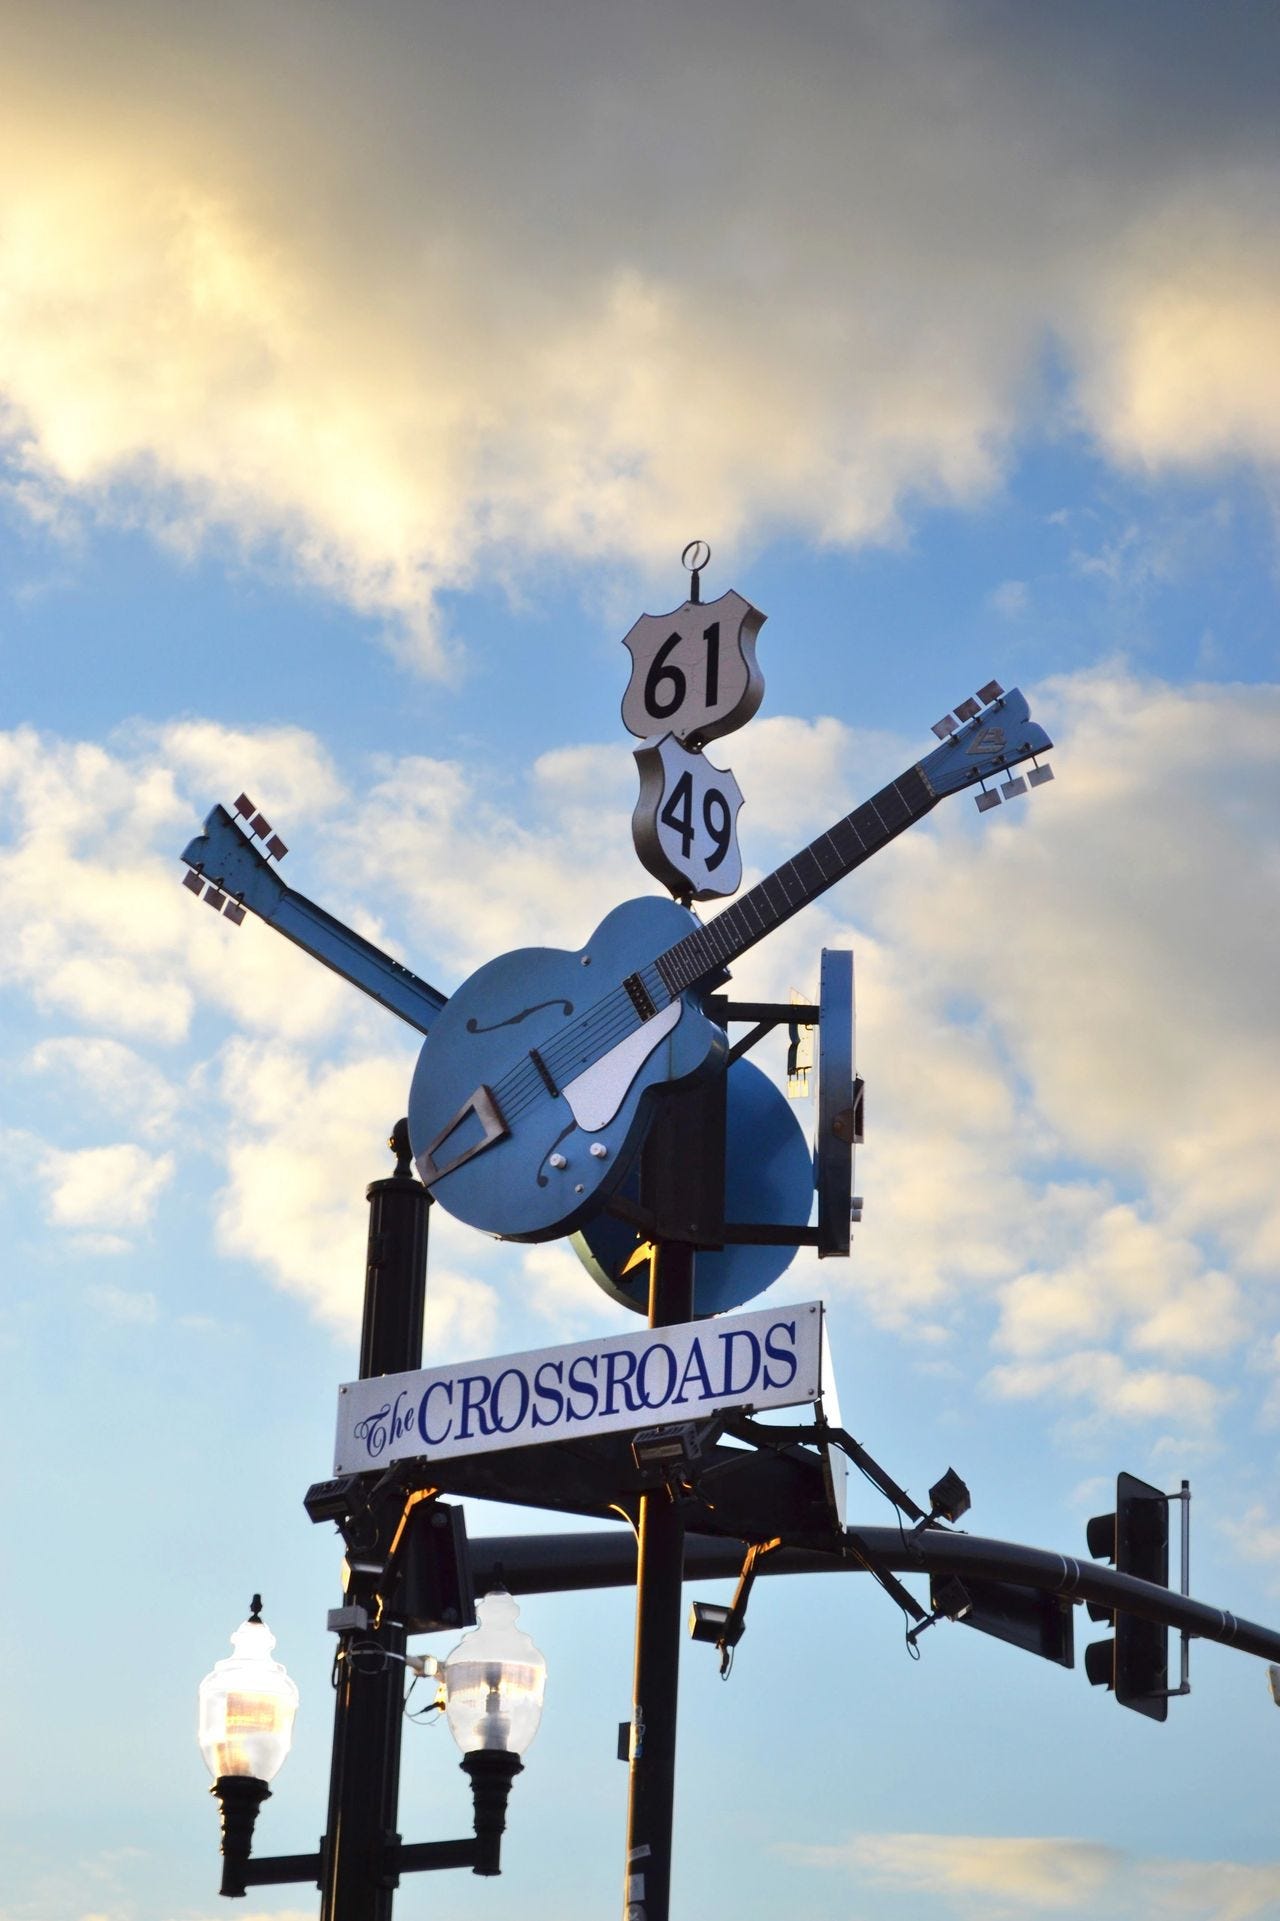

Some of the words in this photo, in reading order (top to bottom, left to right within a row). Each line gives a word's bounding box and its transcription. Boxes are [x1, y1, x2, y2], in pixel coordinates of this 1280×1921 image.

[645, 622, 720, 719] 61
[661, 771, 731, 872] 49
[354, 1390, 414, 1457] The
[418, 1322, 797, 1444] CROSSROADS
